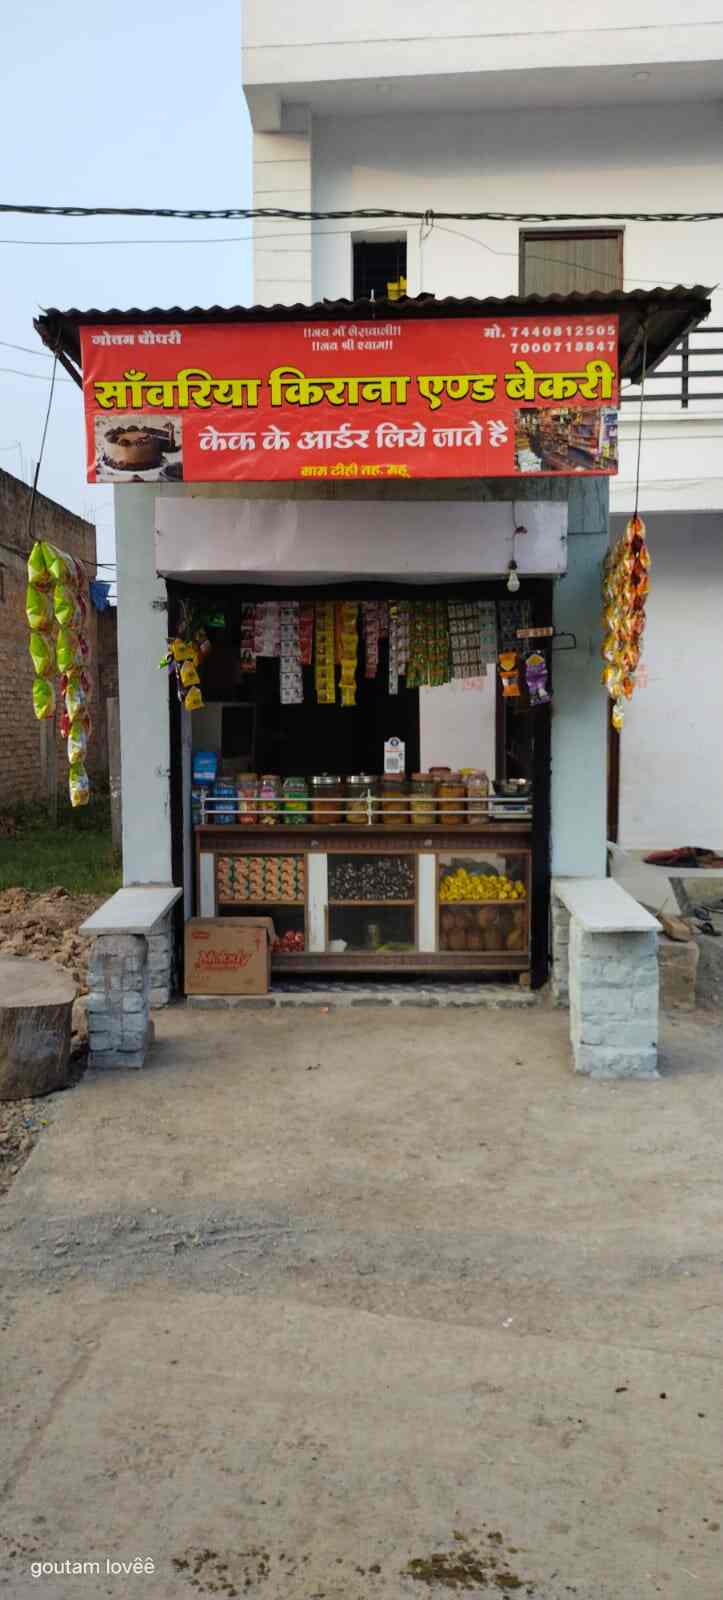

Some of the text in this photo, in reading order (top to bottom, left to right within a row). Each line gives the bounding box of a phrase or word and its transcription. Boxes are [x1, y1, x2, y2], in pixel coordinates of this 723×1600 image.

[94, 358, 616, 410] साँवरिया किराना एण्ड बेकरी
[198, 425, 256, 451] केक
[261, 425, 290, 451] के
[296, 422, 370, 450] आर्डर
[376, 421, 427, 448] लिये
[433, 420, 483, 447] जाते
